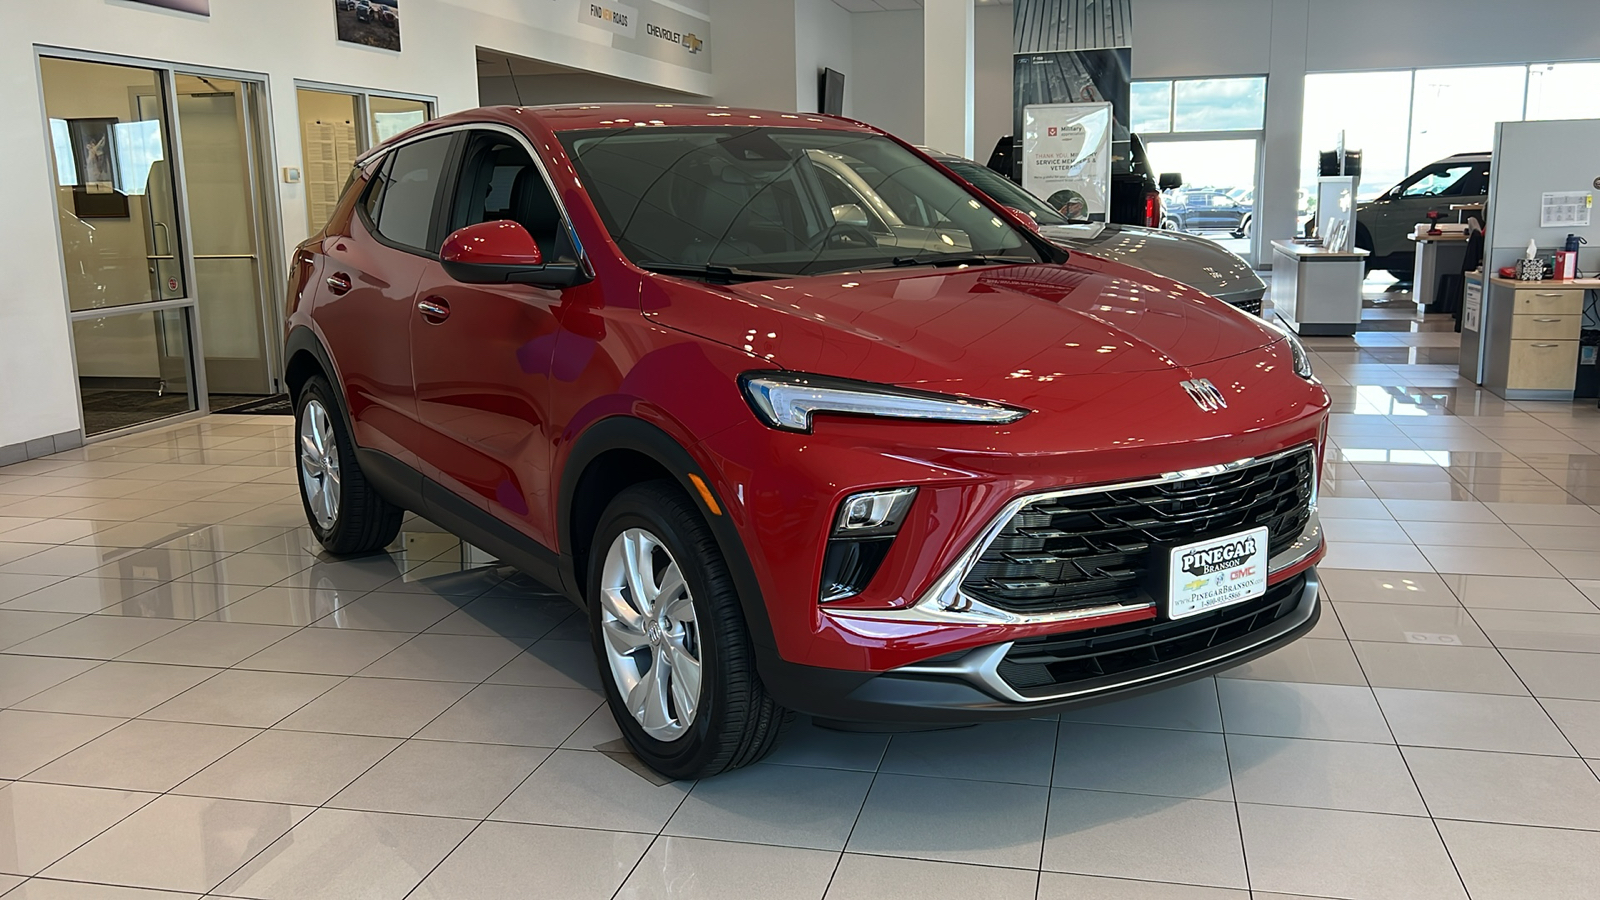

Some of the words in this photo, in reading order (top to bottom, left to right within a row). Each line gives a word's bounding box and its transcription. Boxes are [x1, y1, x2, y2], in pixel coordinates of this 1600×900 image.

[590, 4, 602, 18] FIND
[612, 12, 628, 27] ROADS
[646, 23, 681, 44] CHEVROLET
[1182, 539, 1256, 571] PINEGAR
[1203, 558, 1240, 574] BRANSON
[1230, 566, 1256, 580] GMC
